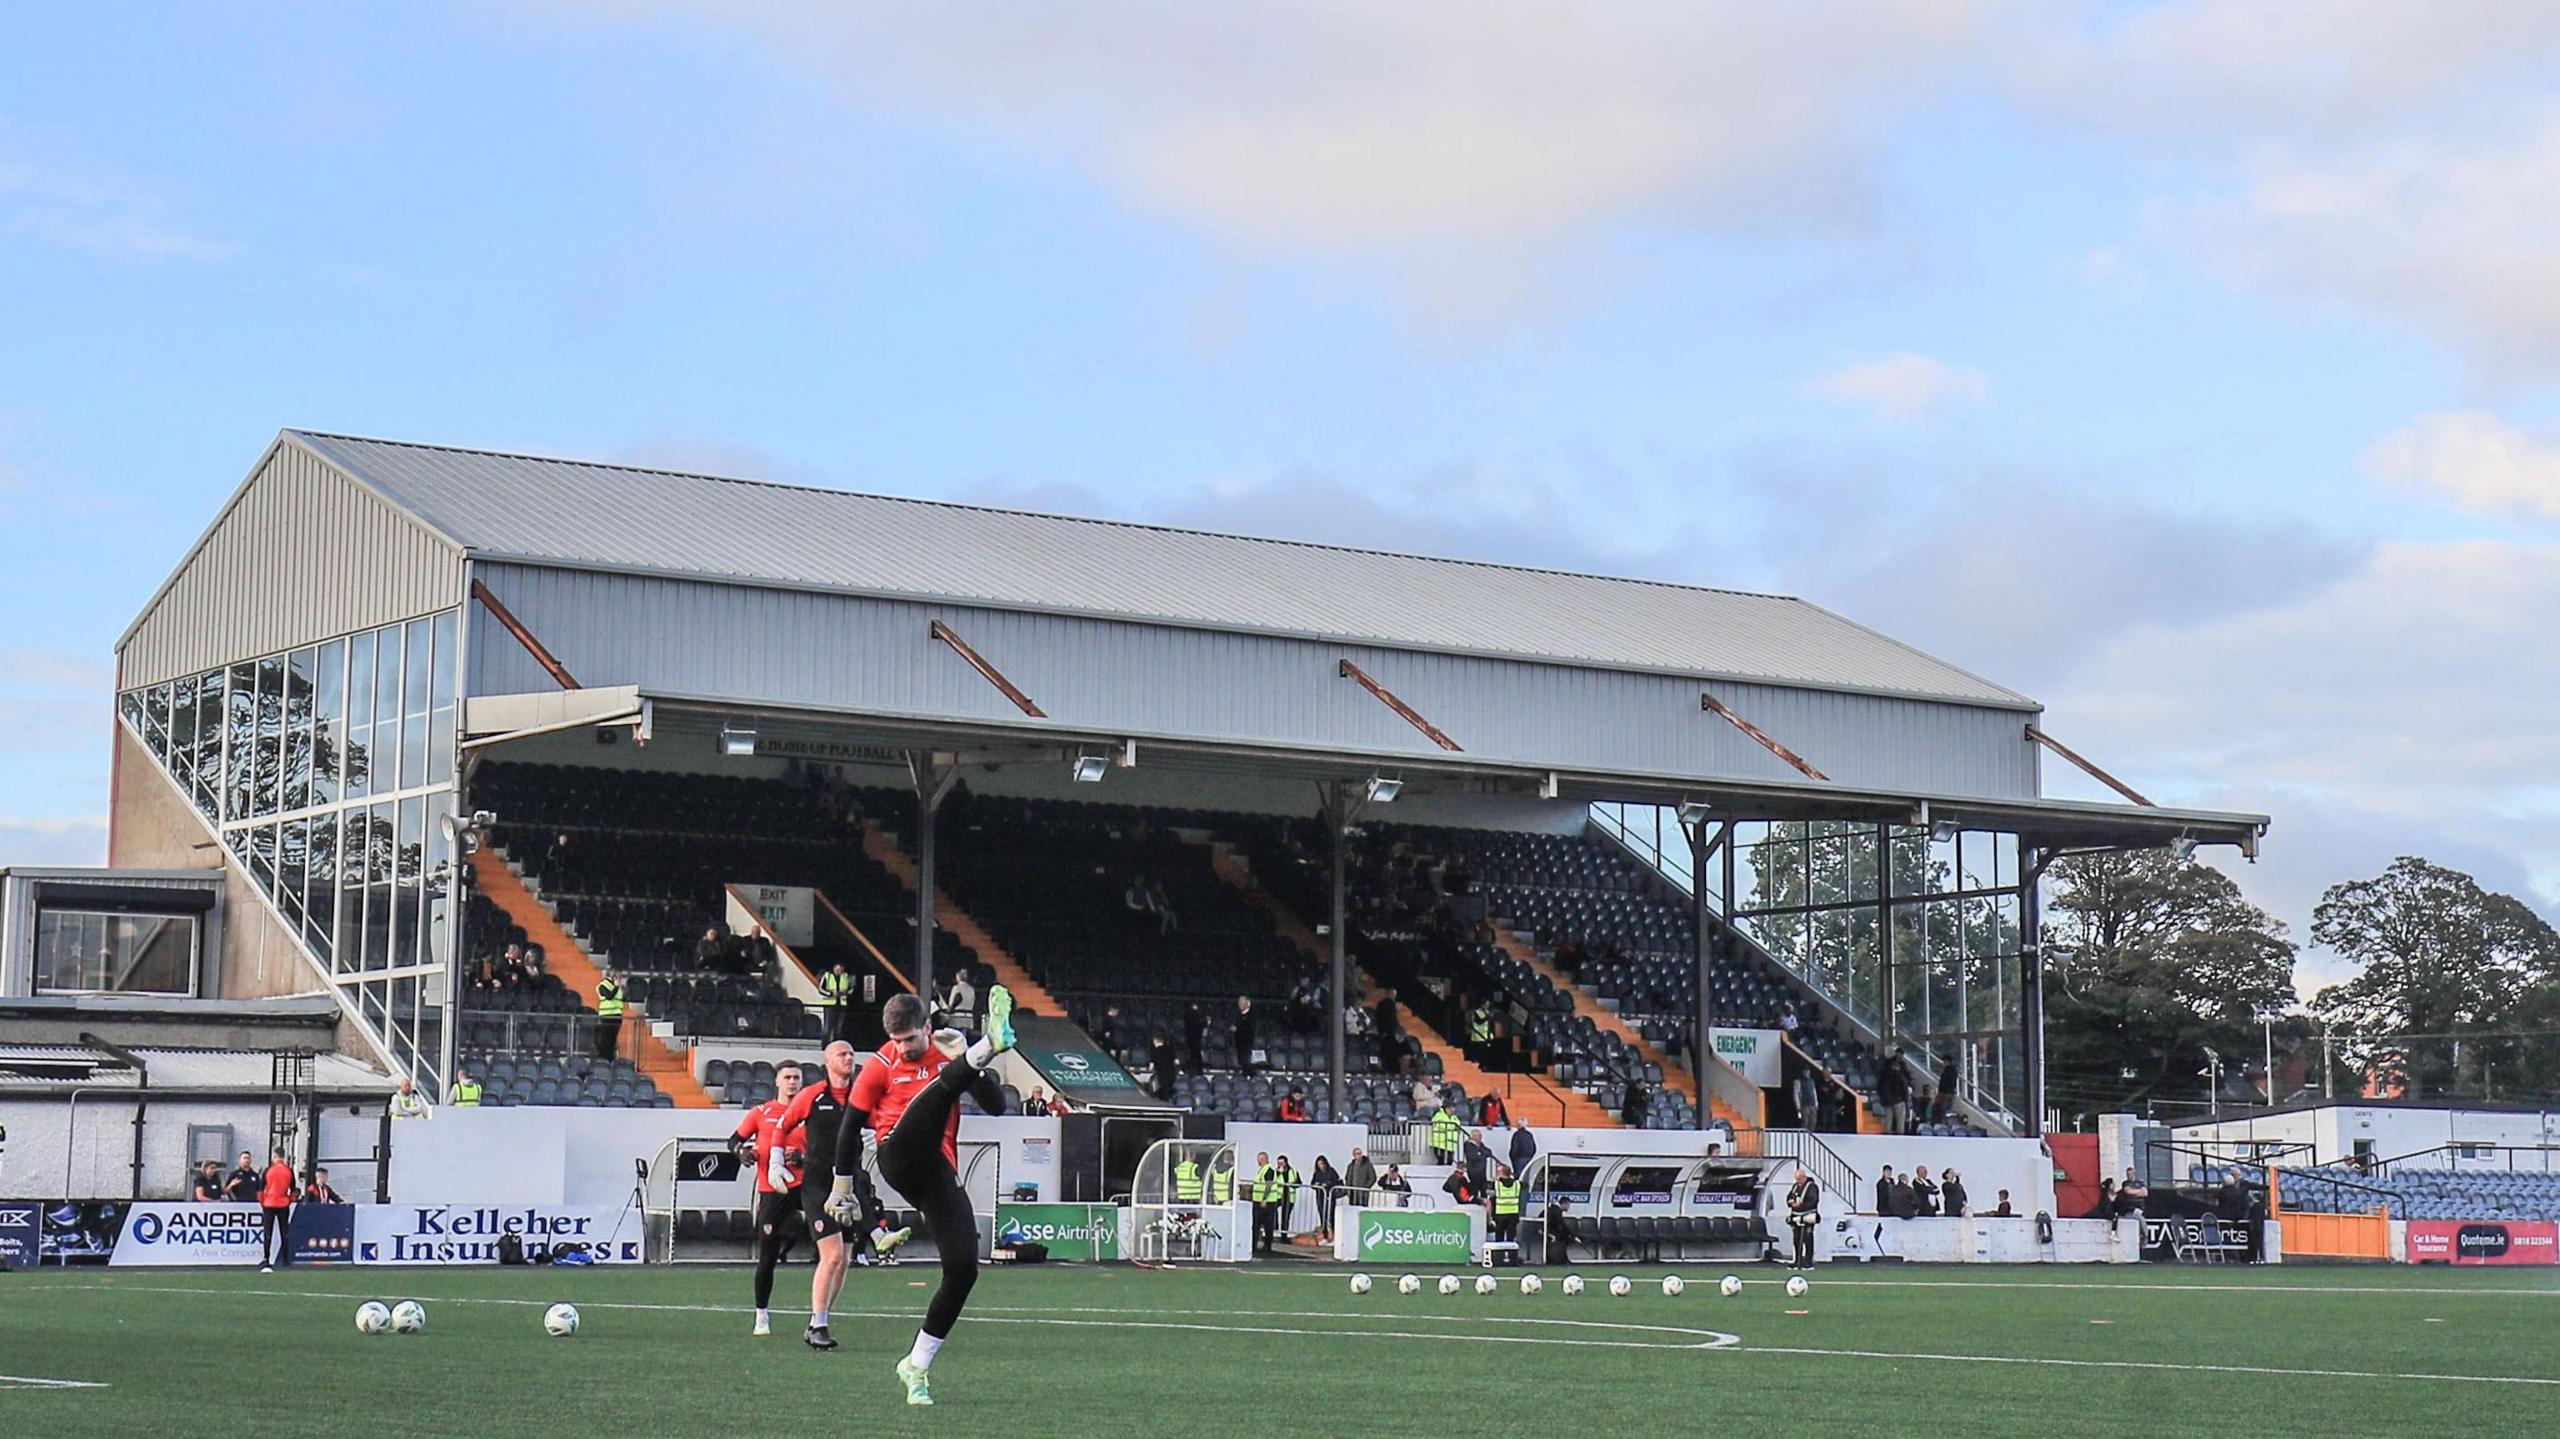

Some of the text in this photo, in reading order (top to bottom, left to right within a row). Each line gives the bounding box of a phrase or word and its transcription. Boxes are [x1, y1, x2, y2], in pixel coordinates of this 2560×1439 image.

[760, 888, 787, 901] EXIT
[760, 906, 787, 921] EXIT
[1717, 1035, 1757, 1054] EMERGENCY
[1730, 1060, 1745, 1078] XIT
[168, 1212, 265, 1228] ANORD
[414, 1208, 592, 1236] Kelleher
[166, 1229, 265, 1245] MARDIX
[1022, 1223, 1115, 1245] sse Airtrity
[1384, 1228, 1468, 1249] sse Airtricity
[2146, 1223, 2248, 1244] TASrts
[2460, 1234, 2505, 1247] Quoteme.ie
[390, 1234, 612, 1262] Insurns
[2417, 1244, 2448, 1252] Insurance
